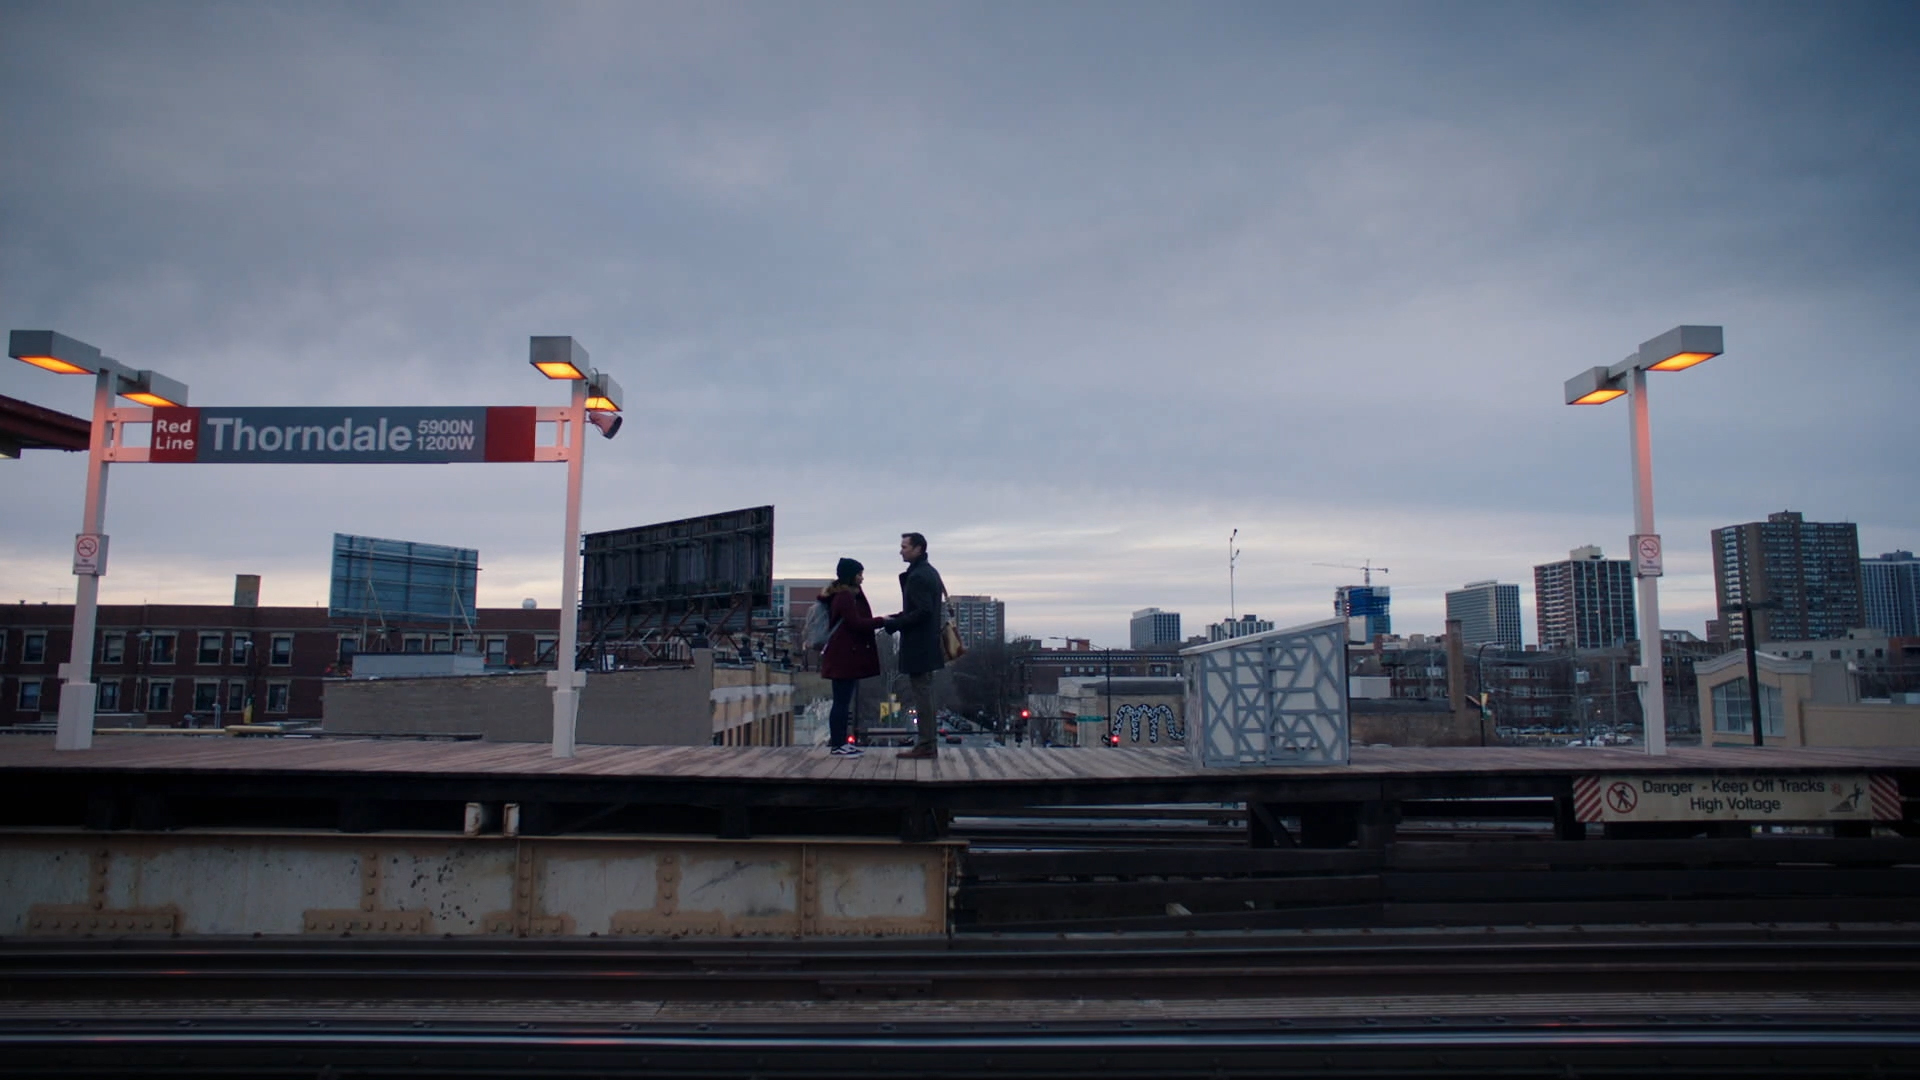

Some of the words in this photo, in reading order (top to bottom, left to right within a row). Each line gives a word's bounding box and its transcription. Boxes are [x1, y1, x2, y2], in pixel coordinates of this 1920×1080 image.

[156, 419, 192, 433] Red
[417, 419, 474, 435] 5900N
[207, 417, 412, 452] Thorndale
[155, 436, 194, 451] Line
[416, 435, 476, 451] 1200W
[1642, 779, 1693, 795] Danger
[1711, 779, 1749, 795] Keep
[1752, 778, 1775, 793] Off
[1780, 778, 1826, 793] Tracks
[1690, 797, 1724, 812] High
[1728, 796, 1781, 812] Voltage
